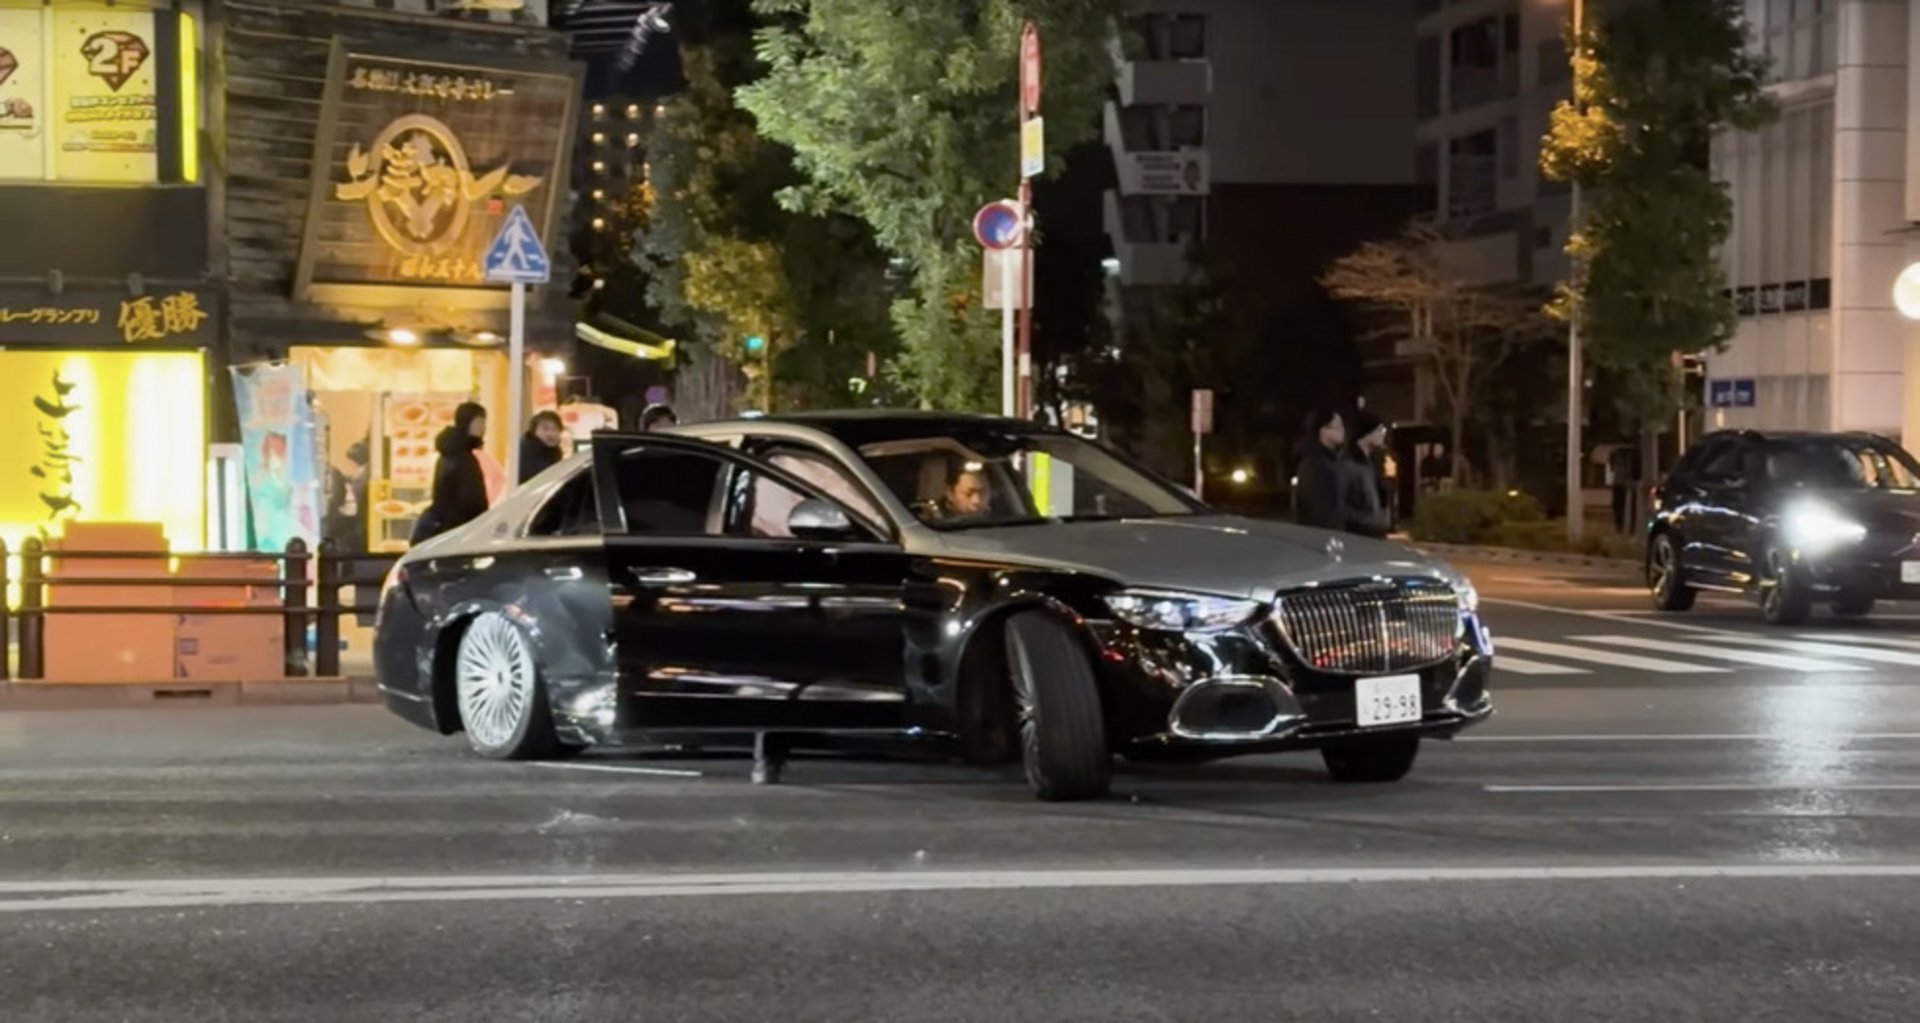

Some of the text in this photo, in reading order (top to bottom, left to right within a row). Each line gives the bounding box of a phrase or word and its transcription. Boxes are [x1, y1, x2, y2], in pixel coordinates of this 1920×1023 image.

[87, 36, 142, 77] 2F
[0, 291, 208, 343] レーグランプリ 優勝
